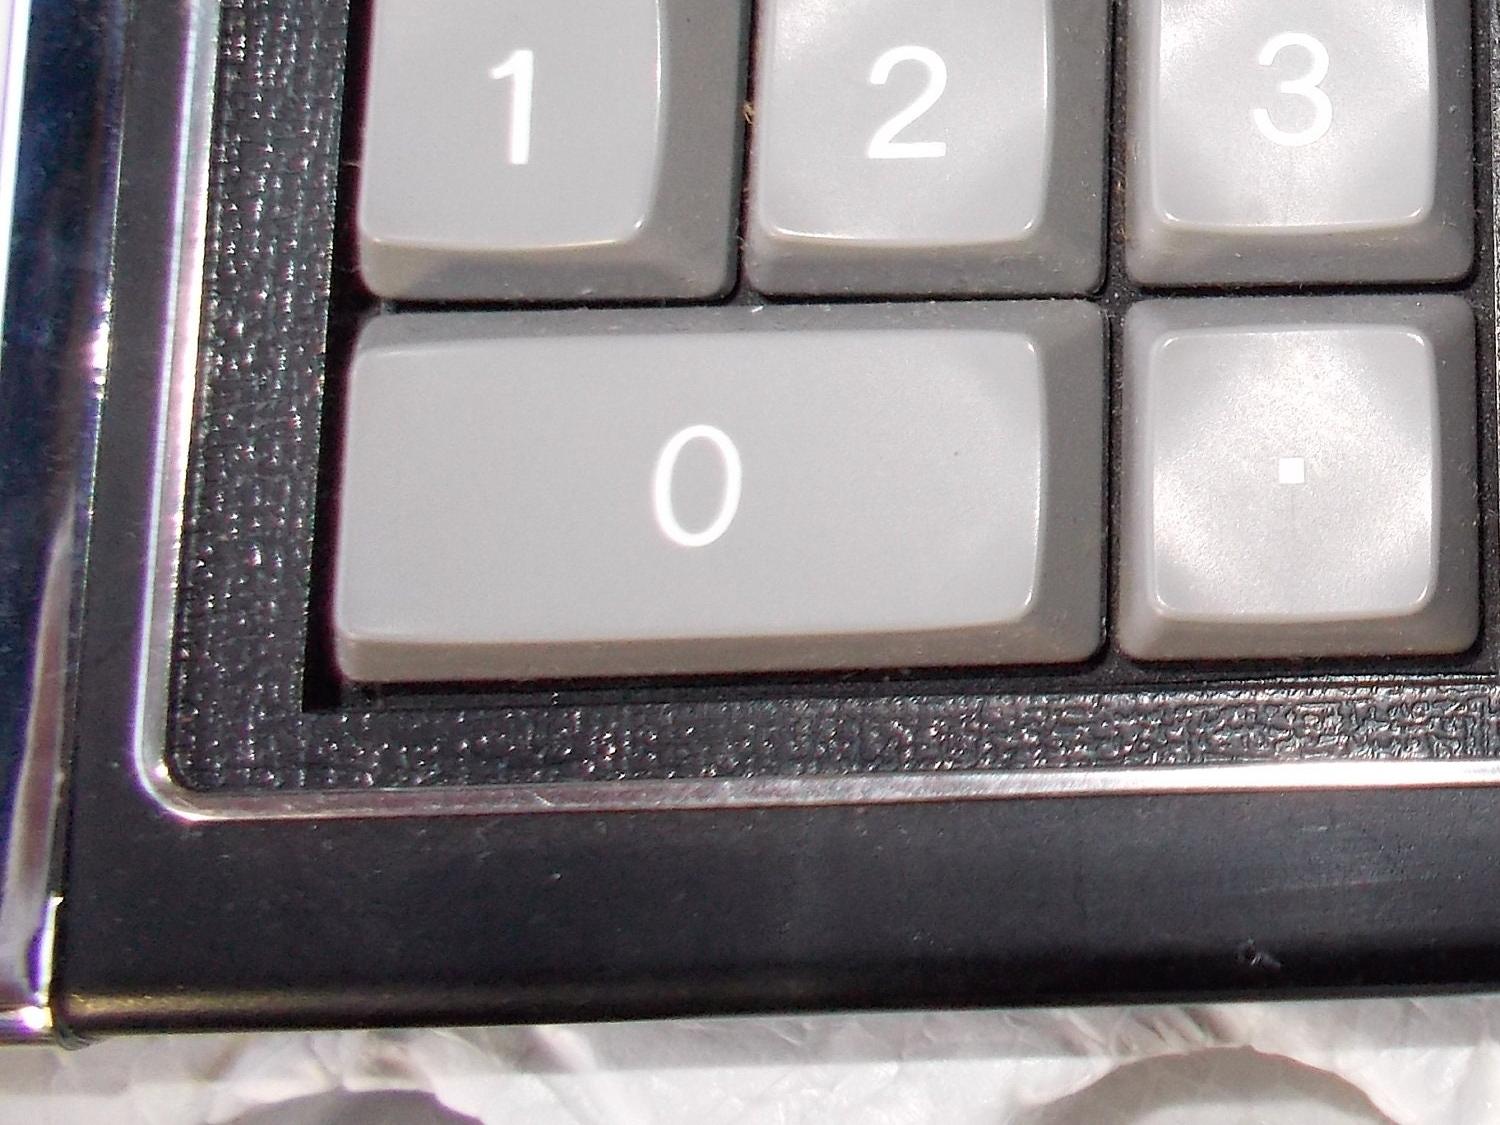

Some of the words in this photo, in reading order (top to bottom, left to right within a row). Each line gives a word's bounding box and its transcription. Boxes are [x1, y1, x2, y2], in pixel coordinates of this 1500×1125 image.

[489, 48, 535, 166] 1
[865, 44, 949, 160] 2
[1251, 31, 1333, 147] 3
[652, 423, 743, 548] 0
